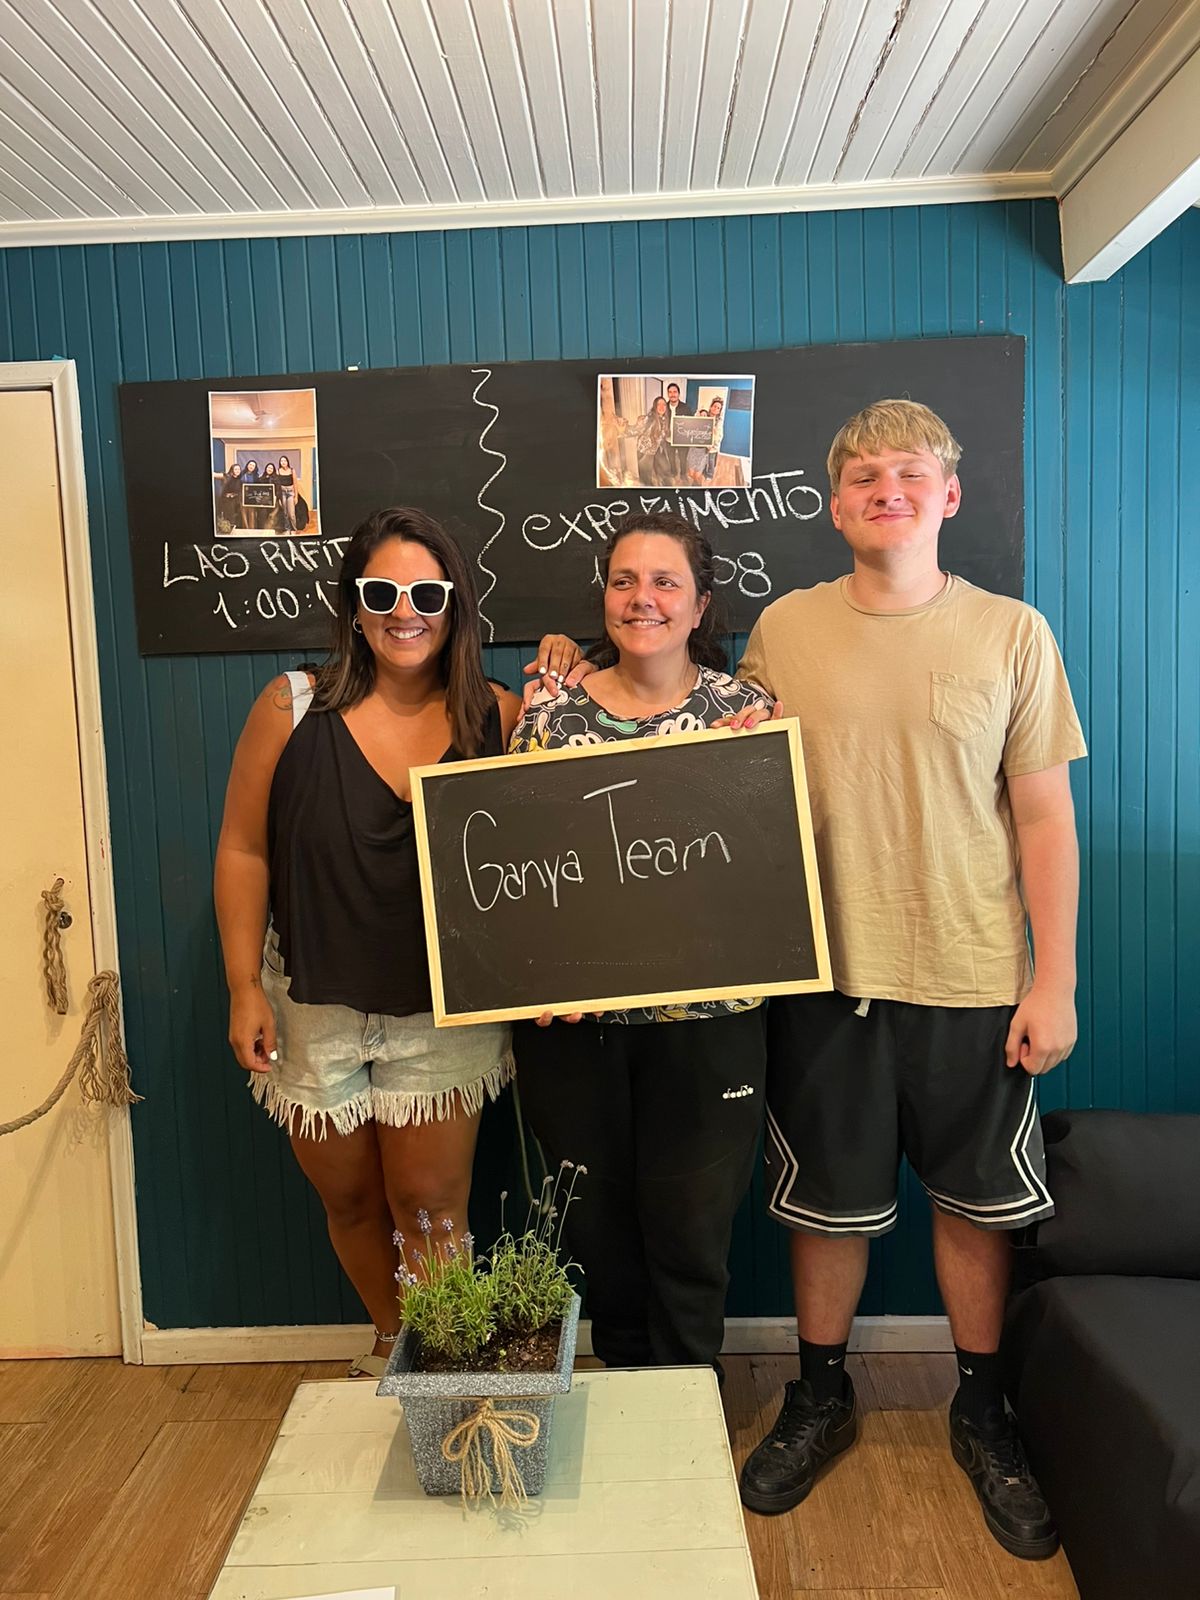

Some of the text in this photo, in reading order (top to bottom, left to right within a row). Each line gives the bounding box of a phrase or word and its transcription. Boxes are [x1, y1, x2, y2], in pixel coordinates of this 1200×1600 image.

[162, 541, 250, 588] LAS
[213, 580, 339, 628] 1:00:1
[463, 779, 731, 911] Ganya Team
